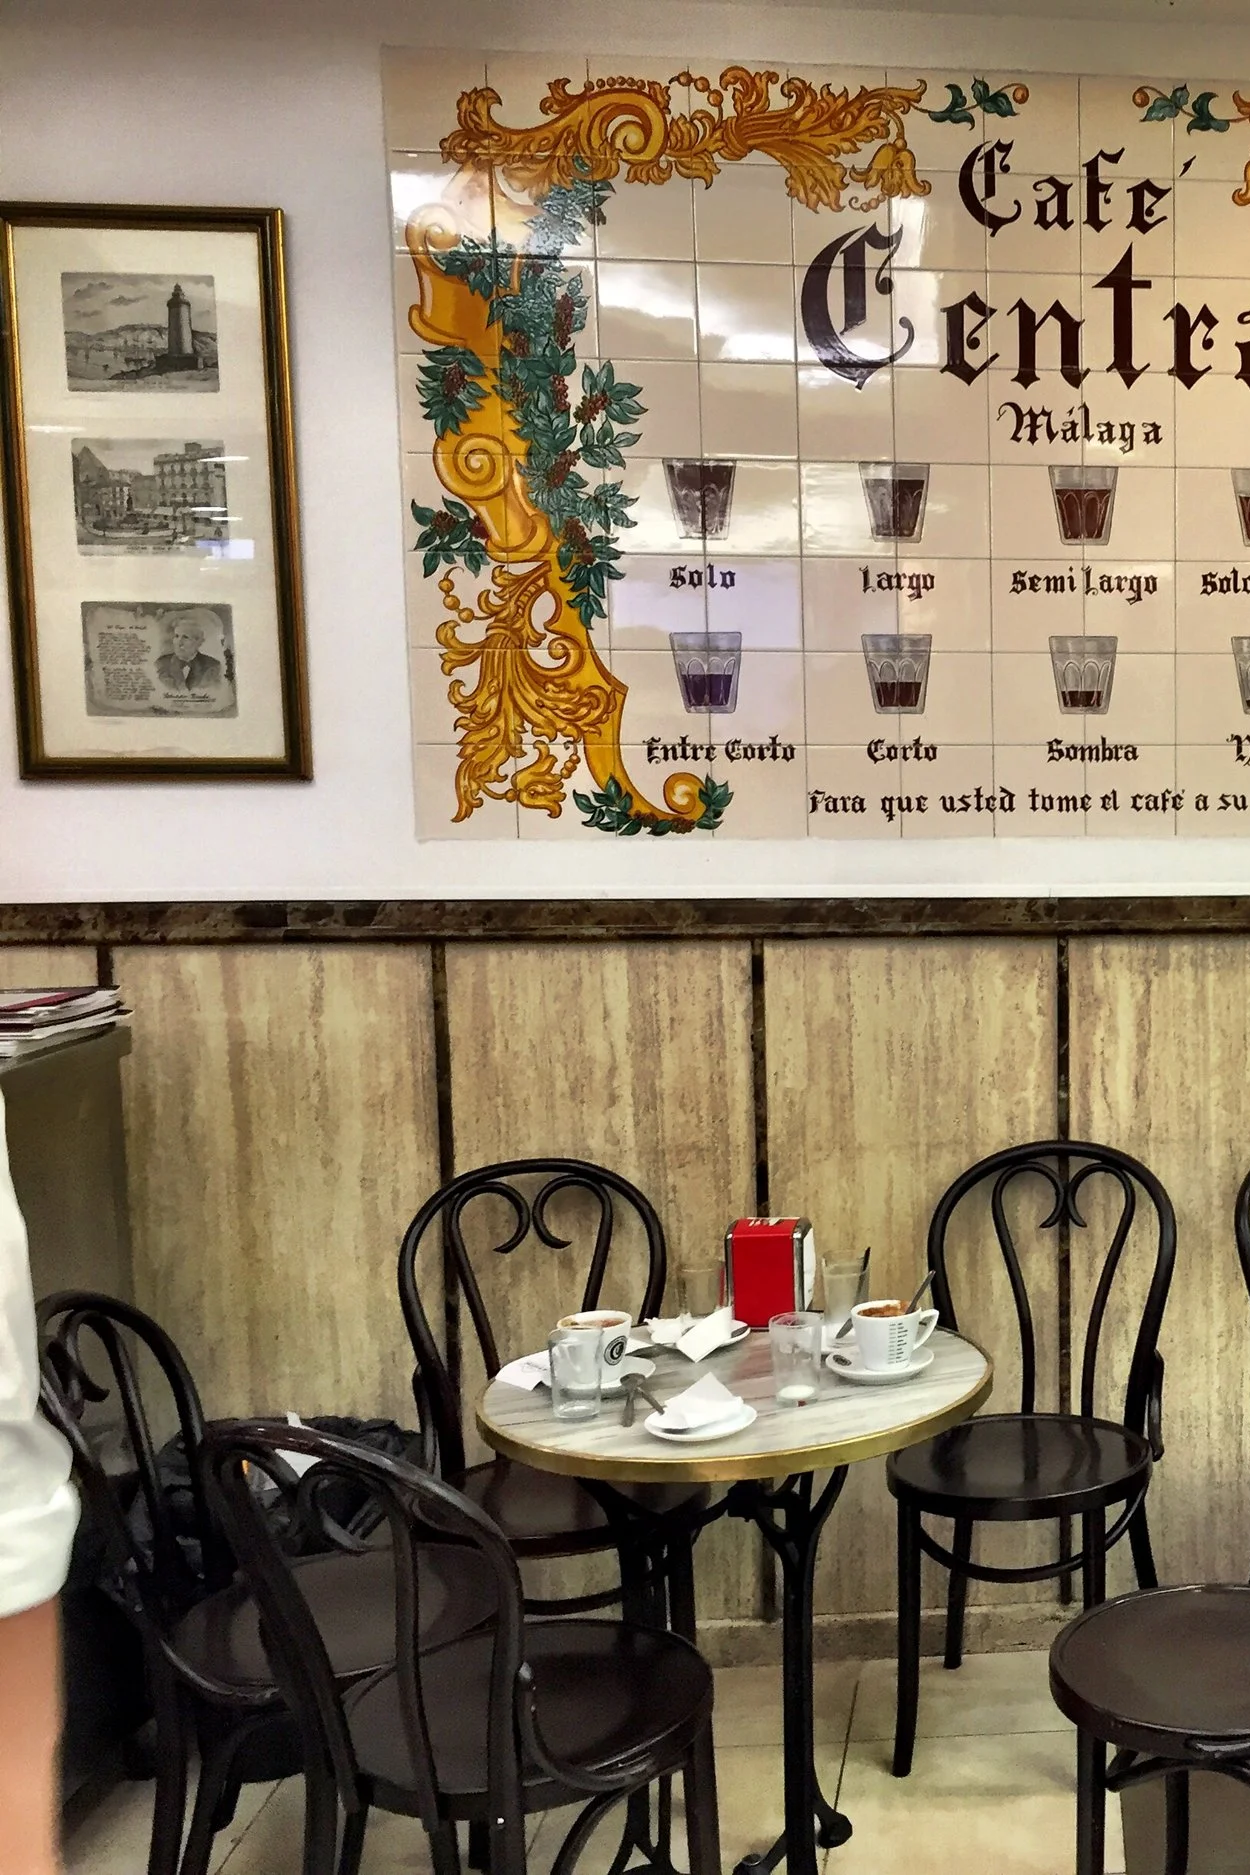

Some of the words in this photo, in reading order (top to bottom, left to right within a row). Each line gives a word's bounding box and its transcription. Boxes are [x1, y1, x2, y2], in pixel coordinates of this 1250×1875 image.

[958, 138, 1197, 238] Café
[996, 401, 1163, 454] Málaga
[669, 563, 736, 589] Solo
[858, 565, 935, 601] Largo
[1009, 566, 1077, 595] Semi
[1081, 565, 1158, 605] Largo
[643, 735, 717, 764] Entre
[725, 735, 796, 763] Corto
[866, 736, 938, 765] Corto
[1046, 736, 1139, 763] Sombra
[808, 788, 867, 814] Para
[880, 793, 928, 821] que
[939, 786, 1016, 813] usted
[1027, 787, 1092, 813] tome
[1100, 788, 1120, 812] el
[1130, 787, 1186, 814] café
[1194, 795, 1210, 812] a
[1216, 794, 1249, 812] su
